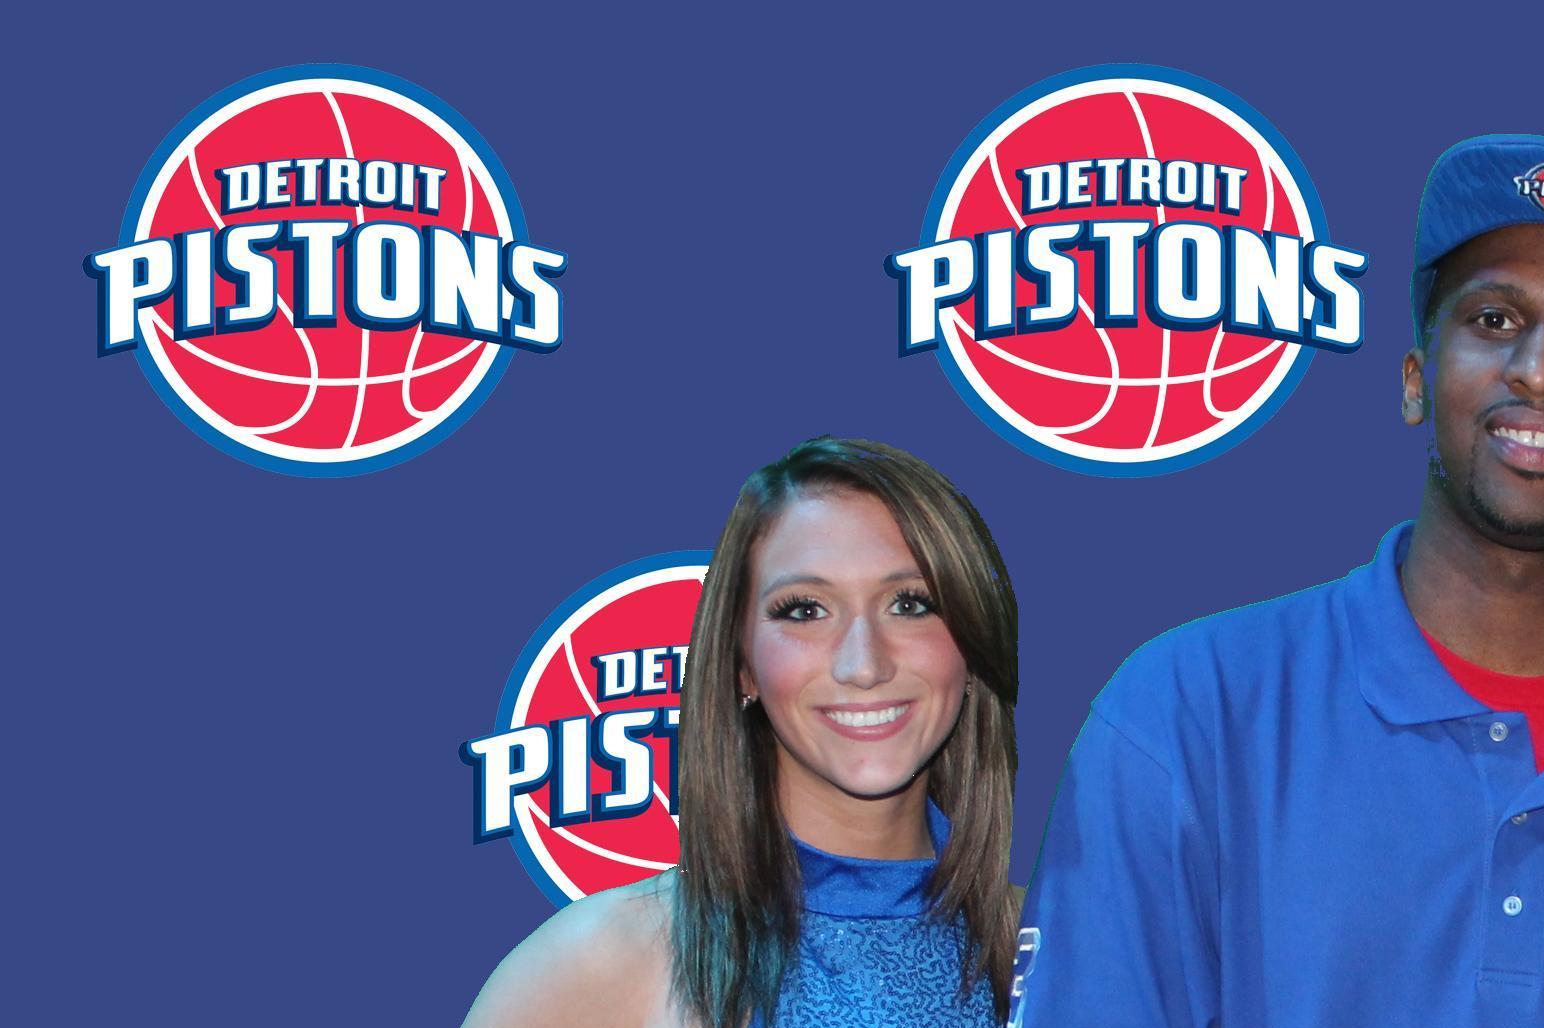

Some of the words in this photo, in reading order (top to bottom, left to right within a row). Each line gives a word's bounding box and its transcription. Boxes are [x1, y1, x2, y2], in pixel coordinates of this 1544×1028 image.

[215, 157, 448, 215] DETROIT
[1016, 157, 1249, 215] DETROIT
[82, 219, 568, 358] PISTONS
[883, 219, 1369, 358] PISTONS
